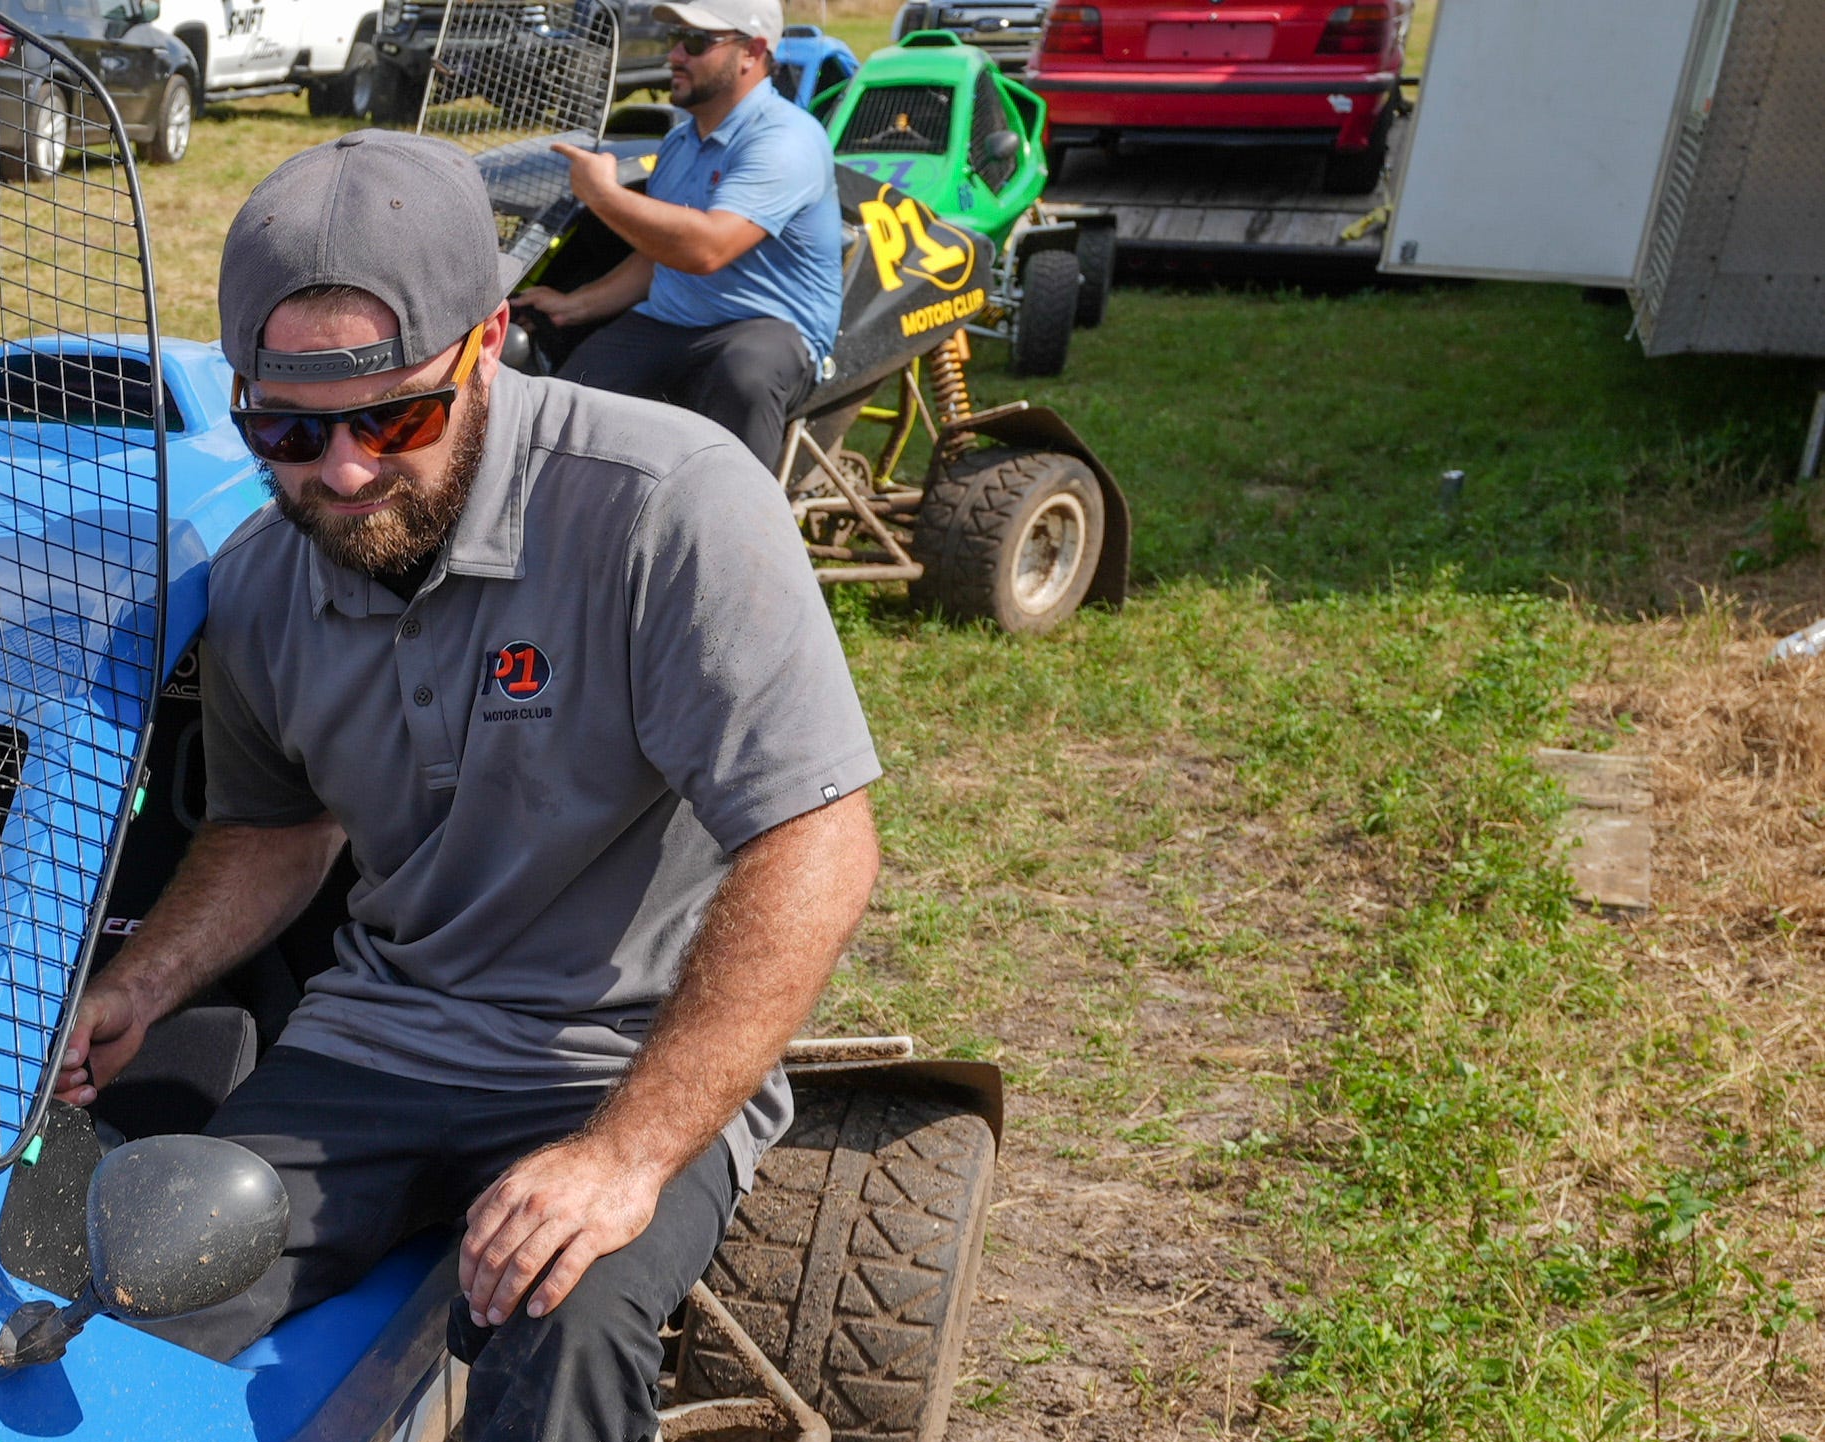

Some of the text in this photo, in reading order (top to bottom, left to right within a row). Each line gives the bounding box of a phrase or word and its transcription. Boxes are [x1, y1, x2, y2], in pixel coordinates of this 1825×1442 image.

[859, 198, 967, 292] P1
[900, 287, 986, 338] MOTOR CLUB
[481, 648, 540, 696] P1
[482, 706, 553, 723] MOTOR CLUB
